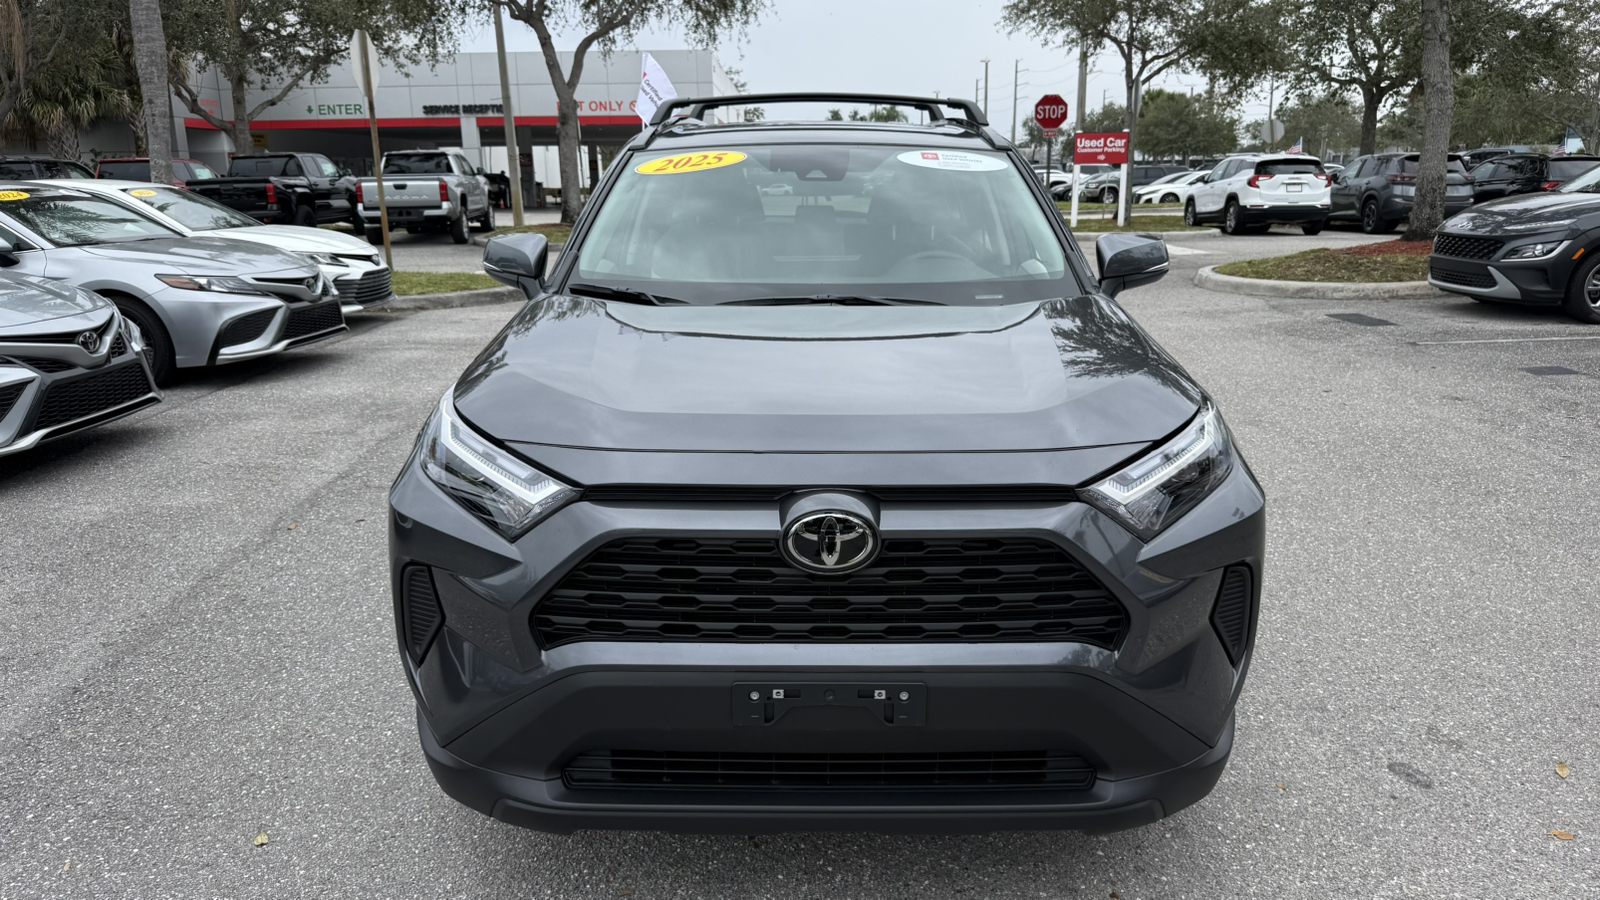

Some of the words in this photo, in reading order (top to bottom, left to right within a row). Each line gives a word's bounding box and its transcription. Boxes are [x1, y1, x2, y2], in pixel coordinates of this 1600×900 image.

[641, 85, 651, 96] sed
[644, 79, 663, 101] Certified
[318, 103, 363, 115] ENTER
[422, 104, 460, 115] SERVICE
[589, 101, 624, 112] ONLY
[1036, 105, 1066, 119] STOP
[1077, 138, 1104, 148] Used
[1106, 137, 1127, 147] Car
[653, 152, 729, 172] 2025
